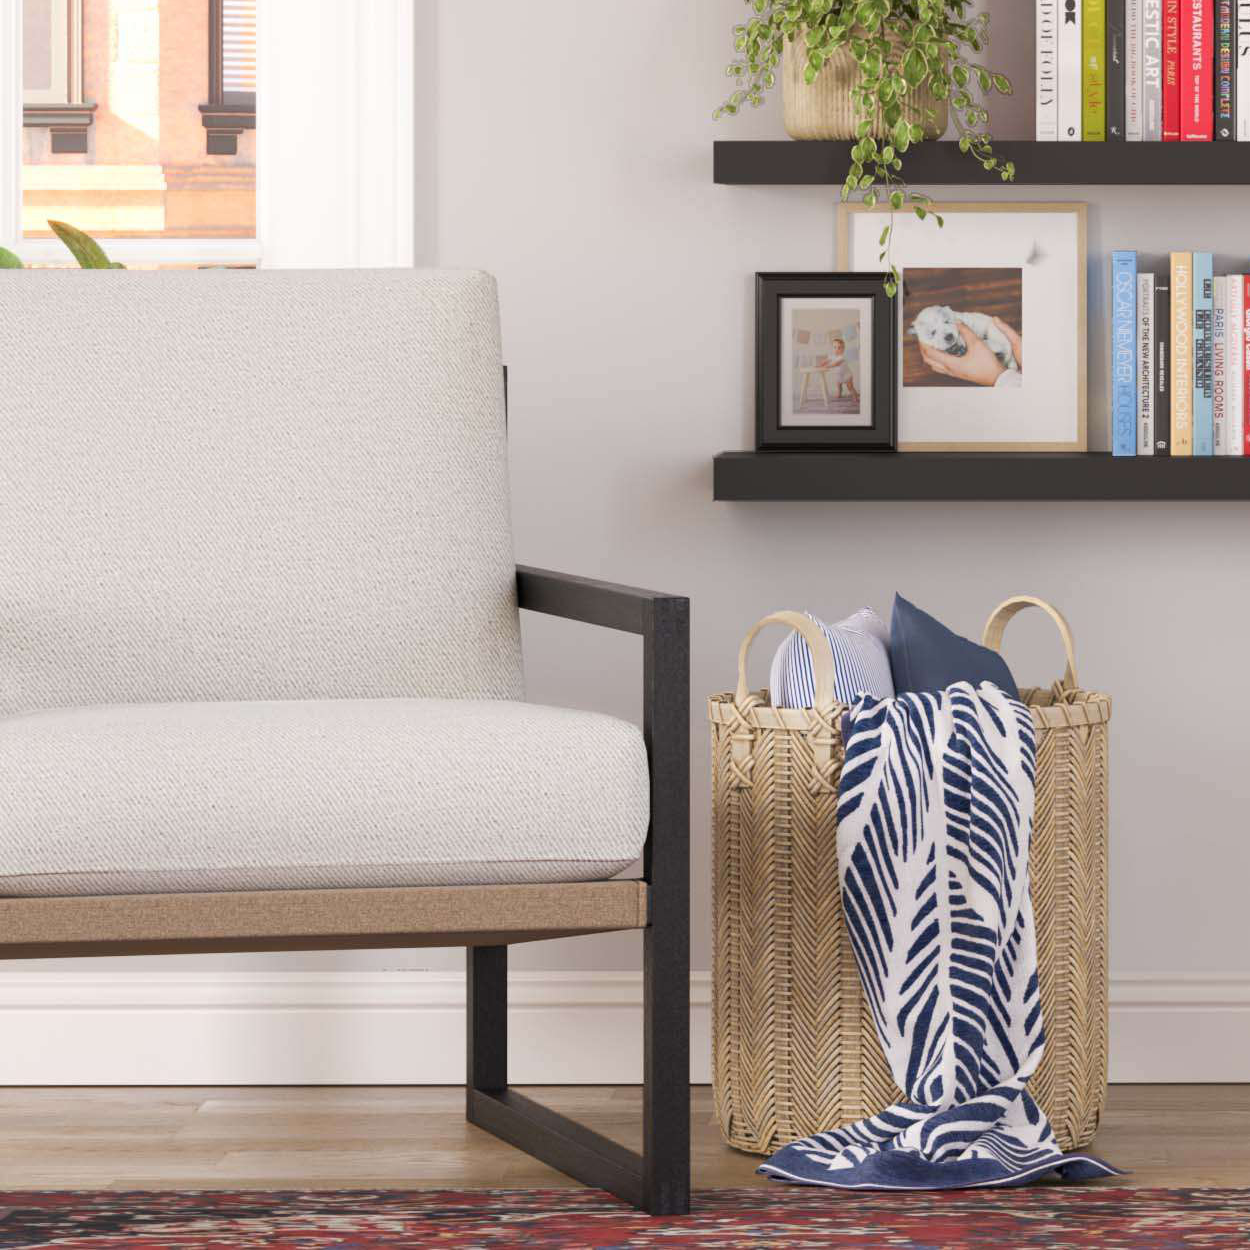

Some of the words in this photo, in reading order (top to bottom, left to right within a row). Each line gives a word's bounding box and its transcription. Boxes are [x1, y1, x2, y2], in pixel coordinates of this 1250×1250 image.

[1167, 1, 1177, 13] IN
[1167, 17, 1177, 54] STYLE
[1145, 56, 1159, 88] ART
[1142, 317, 1149, 327] OF
[1176, 265, 1187, 357] HOLLYWOOD
[1214, 308, 1223, 338] PARIS
[1214, 343, 1223, 376] LIVING
[1176, 358, 1187, 429] INTERIORS
[1214, 381, 1223, 418] ROOMS
